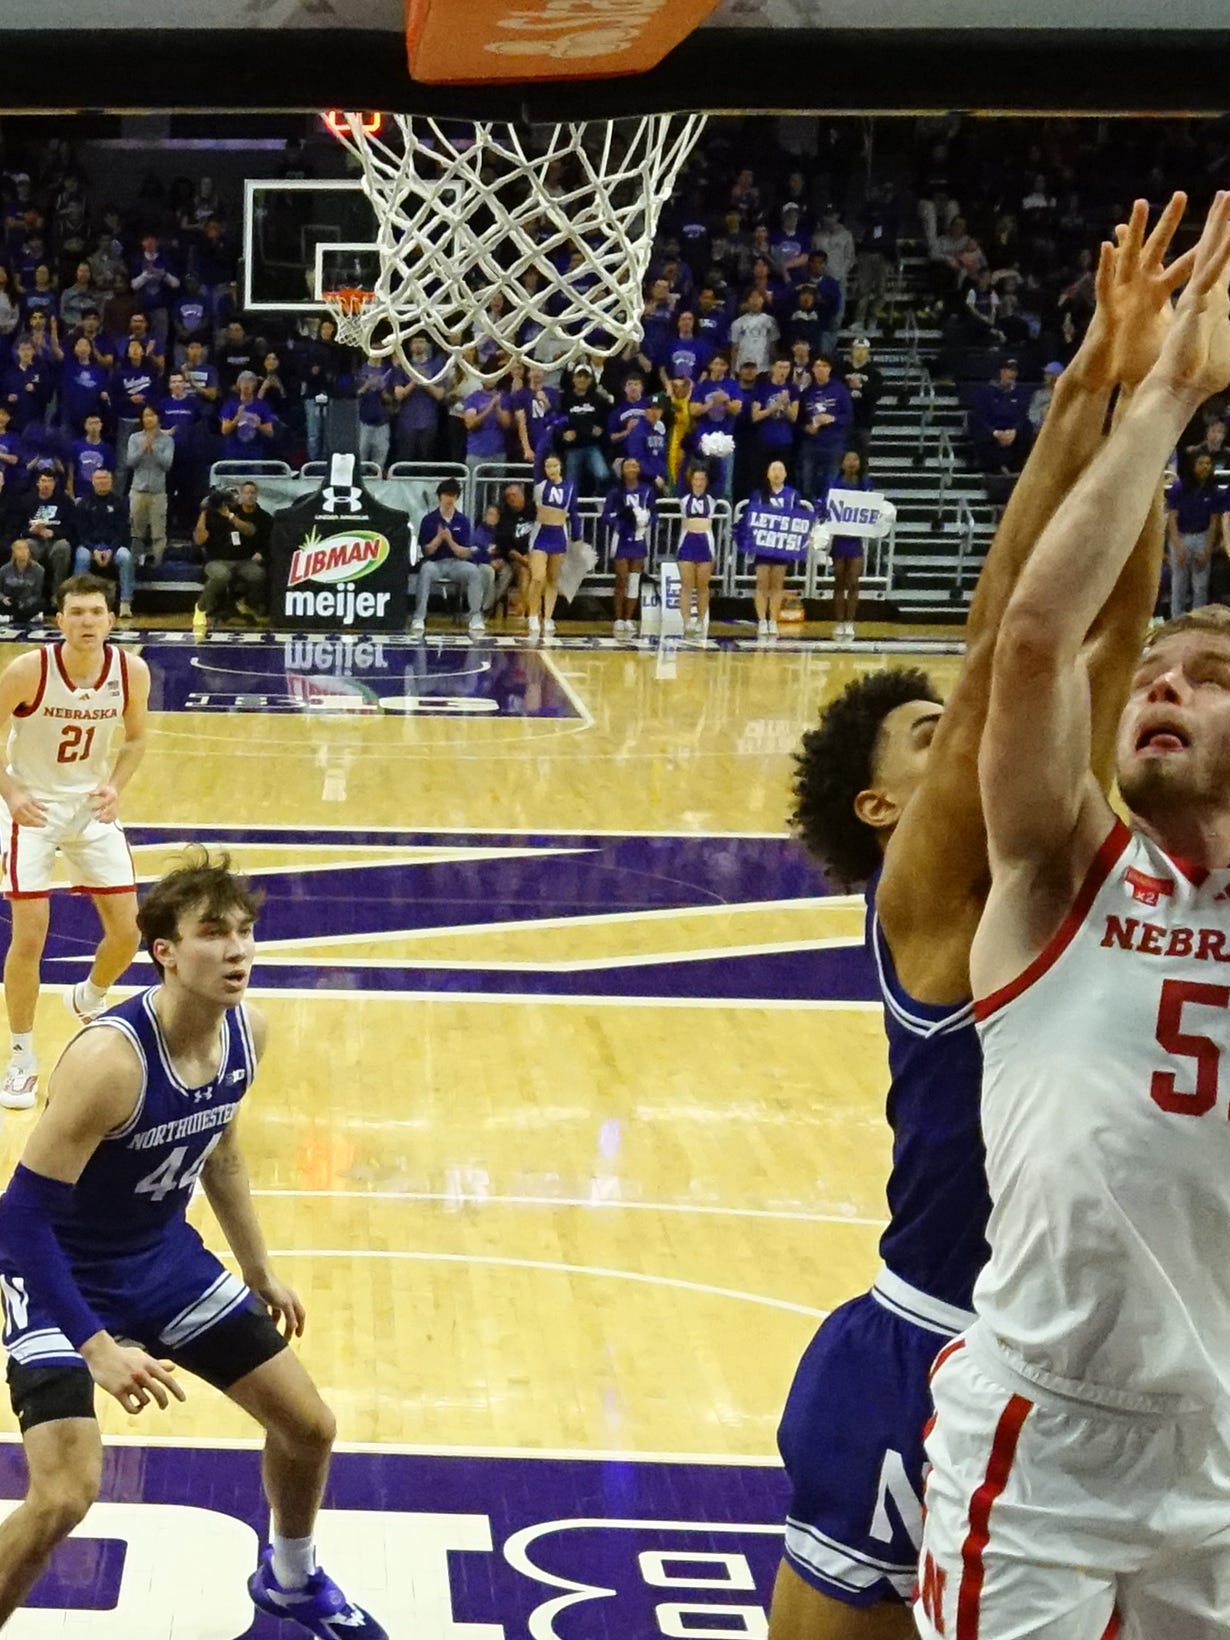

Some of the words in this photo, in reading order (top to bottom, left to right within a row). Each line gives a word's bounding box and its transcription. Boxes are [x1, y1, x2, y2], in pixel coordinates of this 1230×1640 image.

[549, 487, 564, 503] N
[626, 494, 640, 506] N
[691, 499, 704, 514] N
[751, 511, 789, 530] LET'S
[791, 516, 810, 534] GO
[289, 538, 381, 586] LIBMAN
[285, 582, 391, 625] meijer
[43, 707, 118, 719] NEBRASKA
[57, 725, 96, 764] 21
